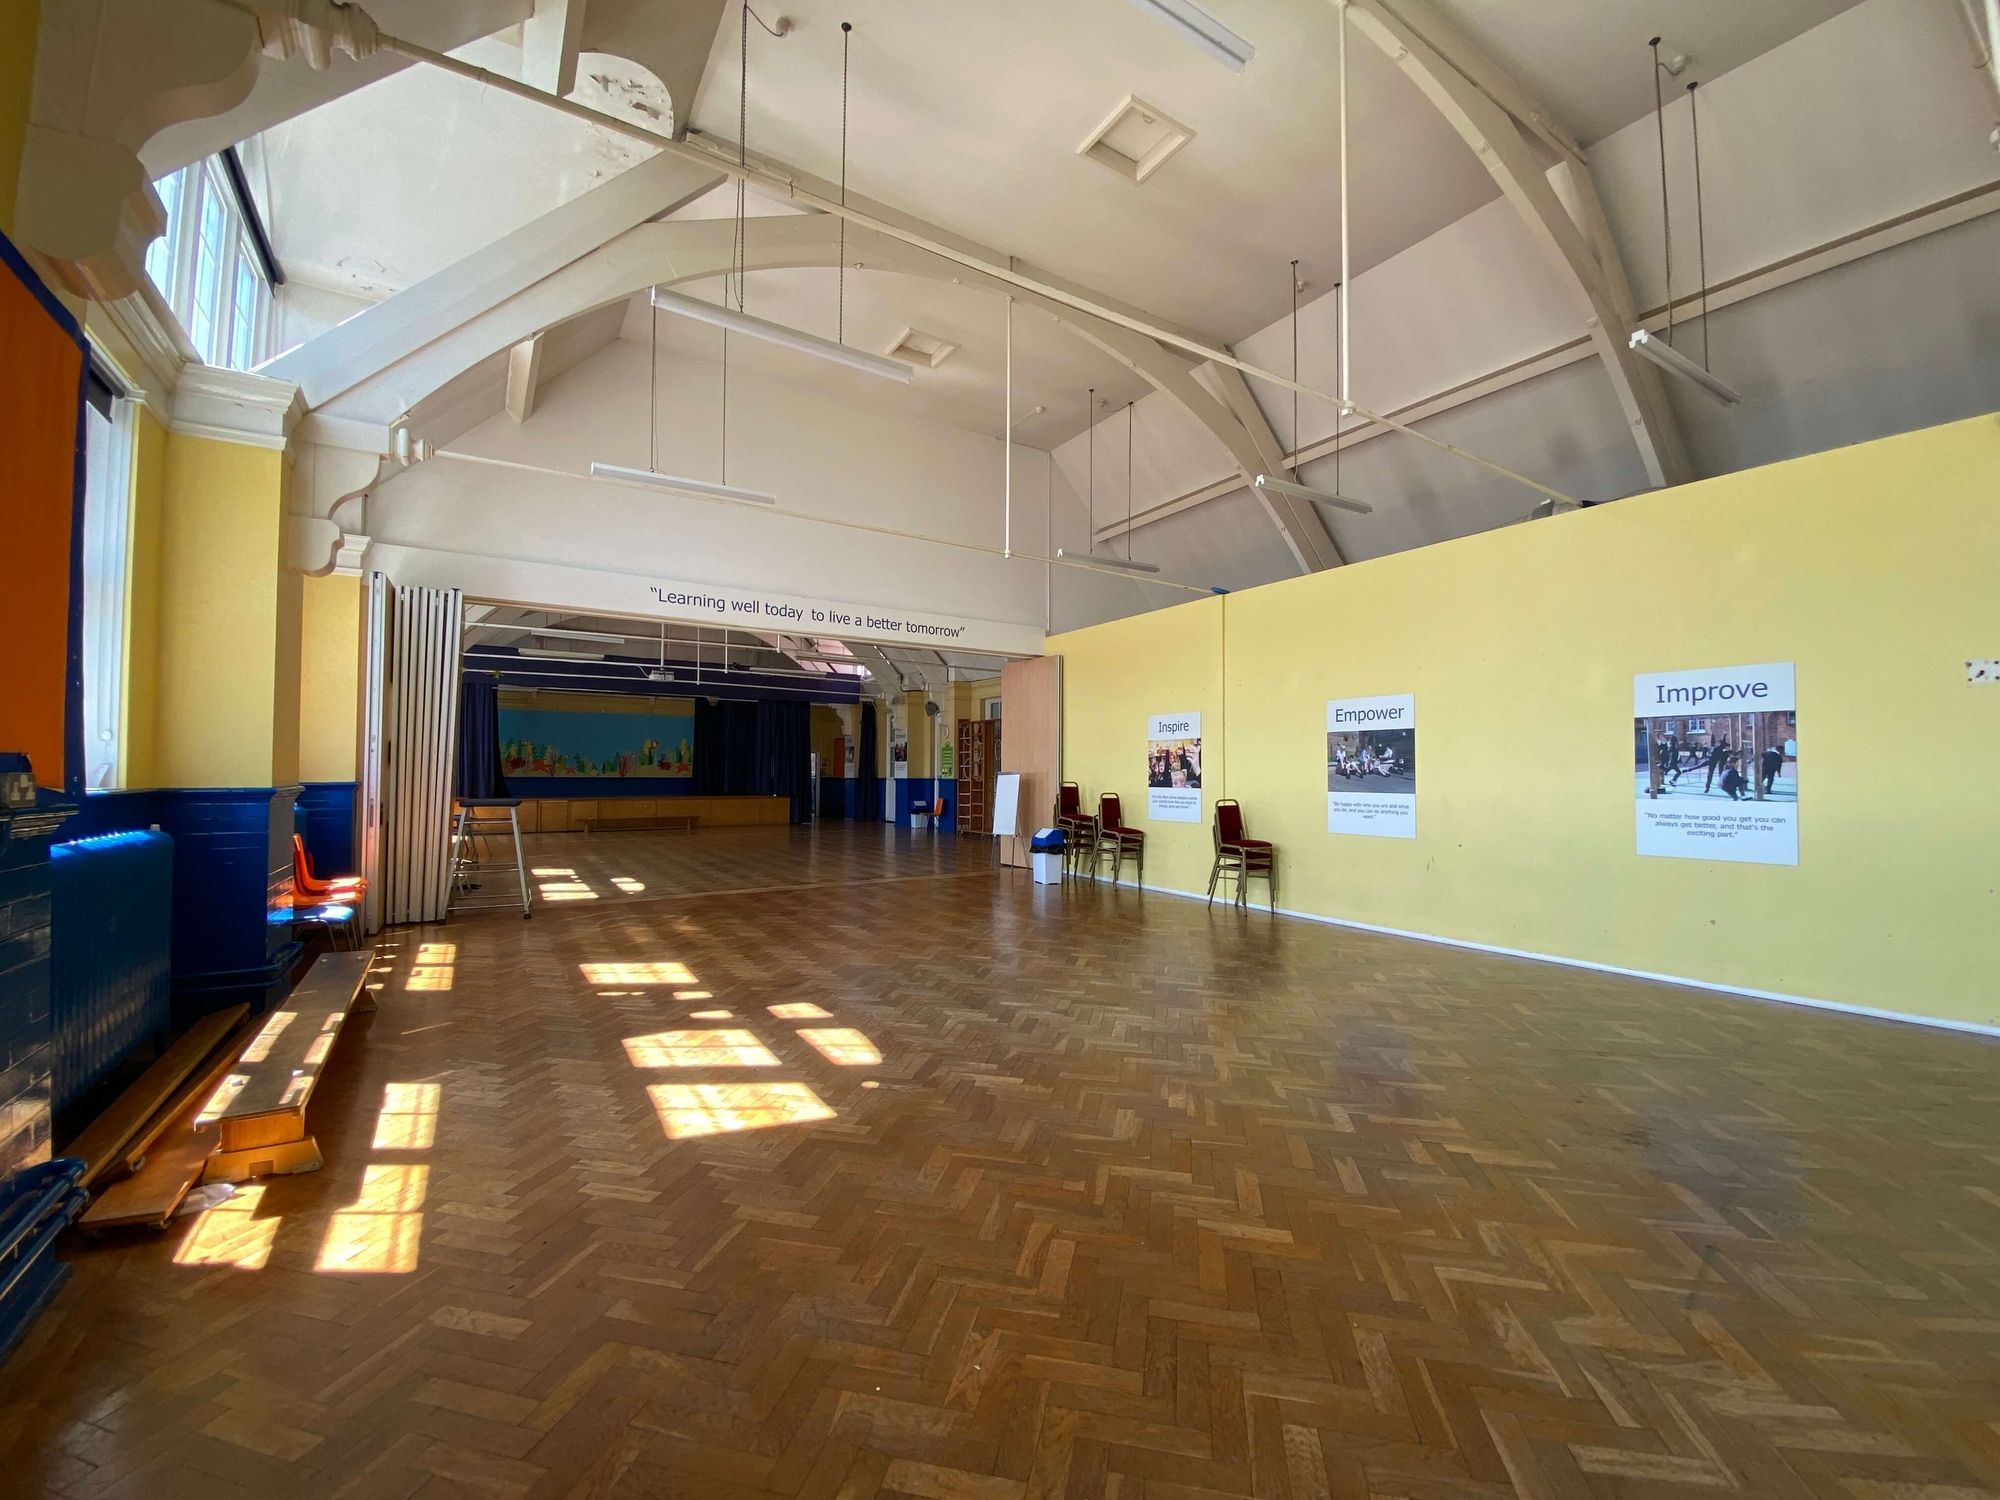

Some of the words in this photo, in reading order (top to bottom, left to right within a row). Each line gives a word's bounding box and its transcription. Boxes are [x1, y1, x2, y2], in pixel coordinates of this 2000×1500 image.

[650, 586, 725, 612] “Learning
[731, 600, 760, 614] well
[765, 602, 803, 621] today
[811, 608, 824, 622] to
[829, 610, 851, 625] live
[854, 616, 862, 626] a
[866, 615, 902, 631] better
[906, 621, 965, 637] tomorrow”
[1656, 682, 1768, 706] Improve
[1335, 708, 1404, 724] Empower
[1158, 721, 1189, 734] Inspire
